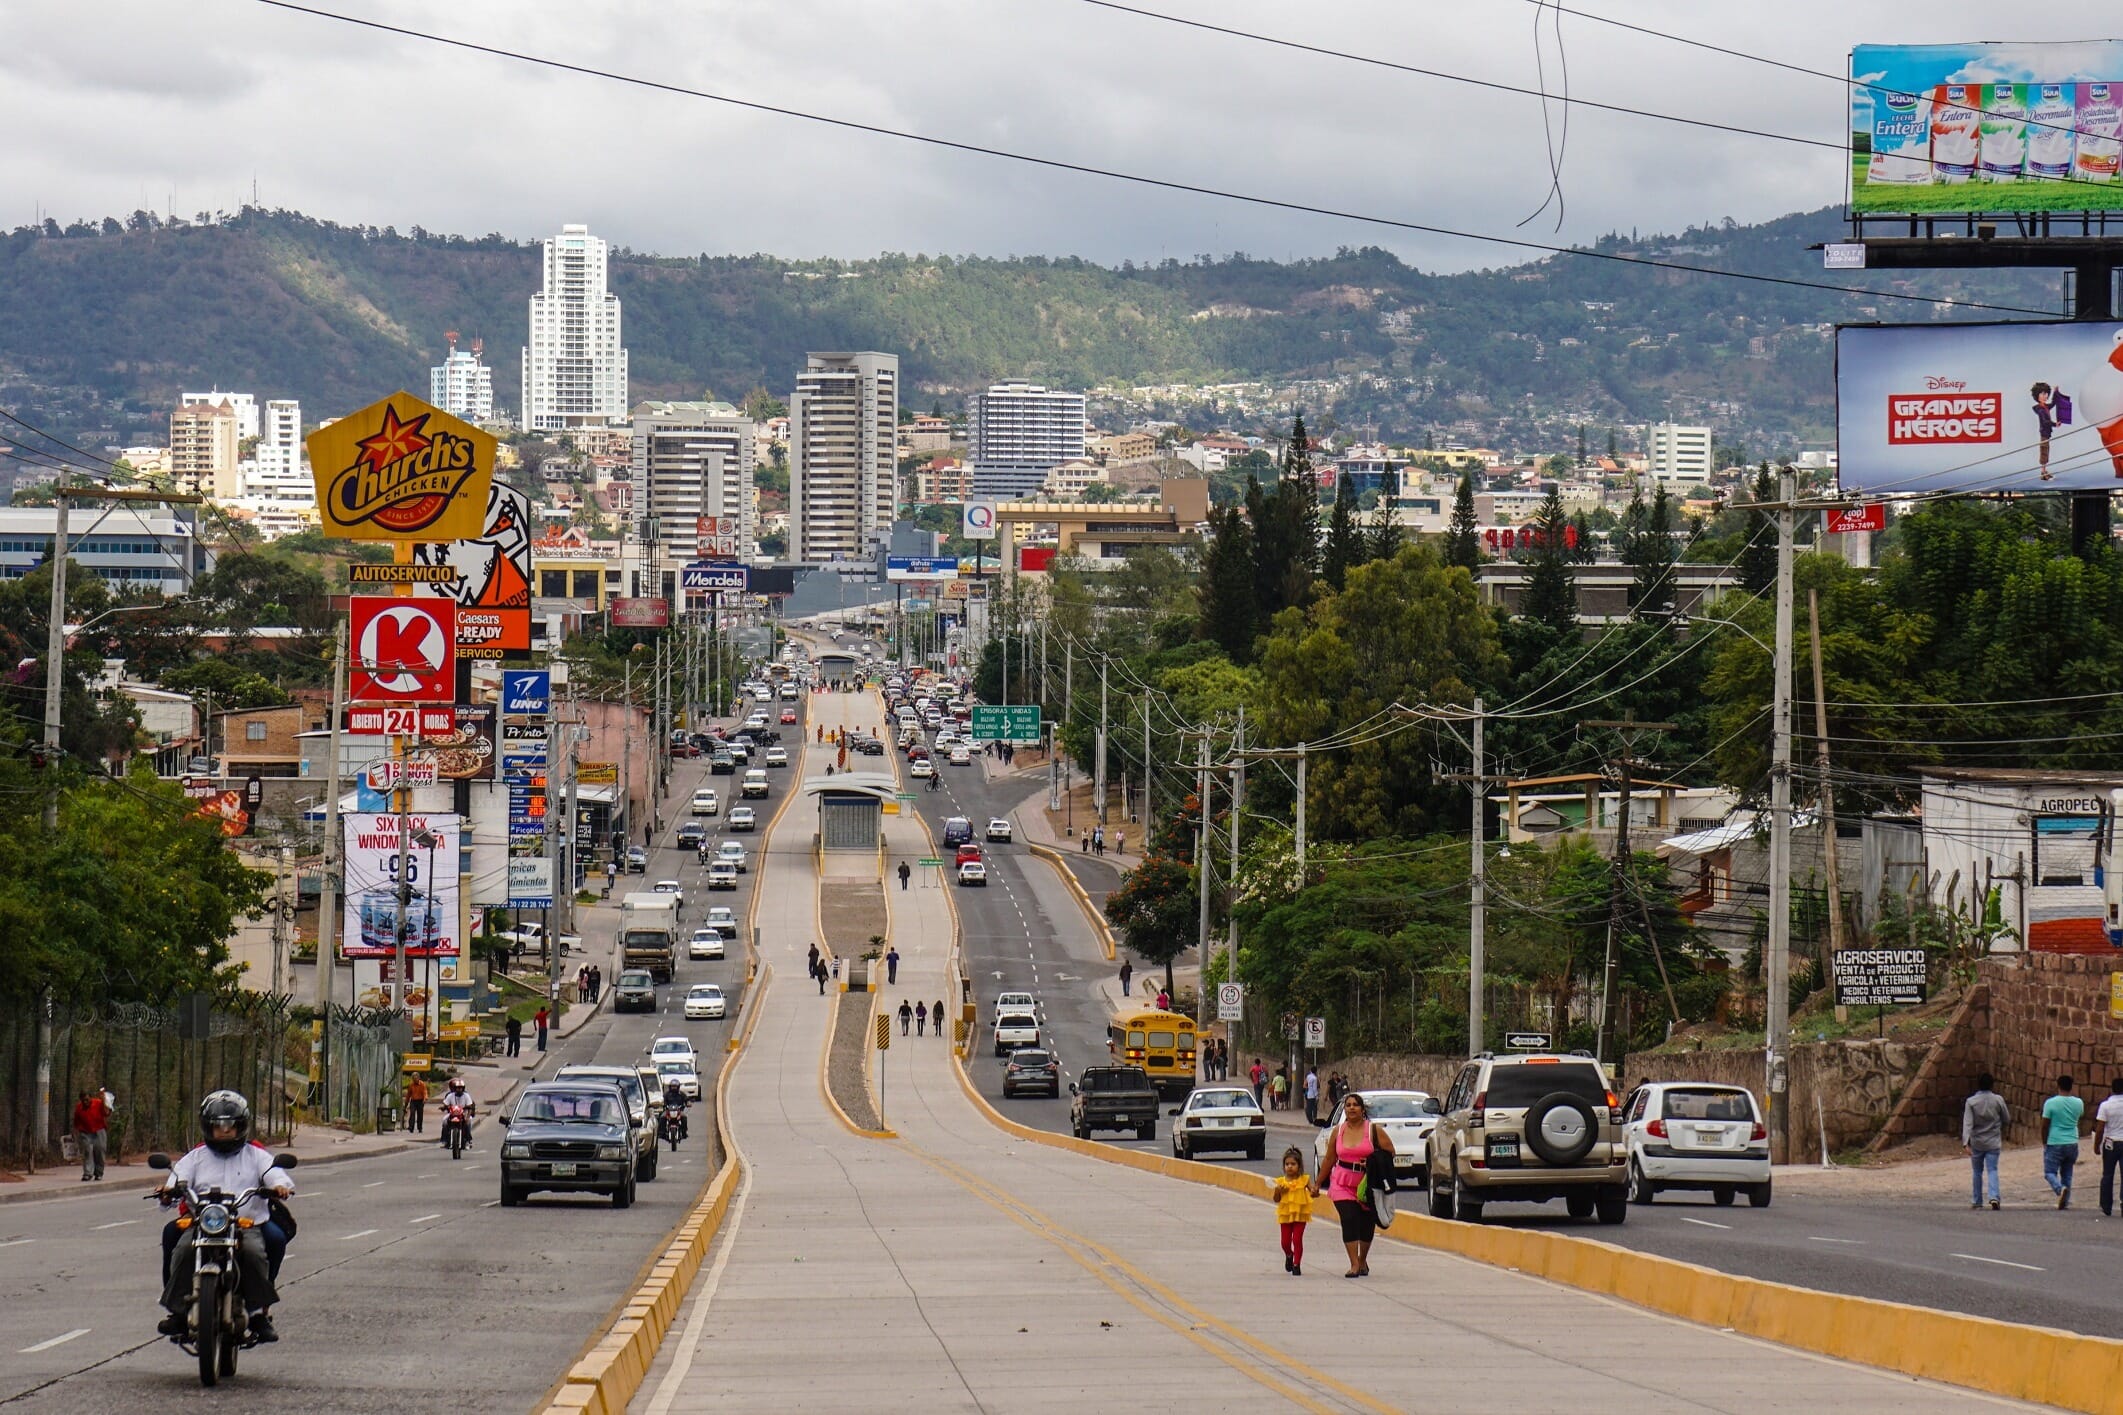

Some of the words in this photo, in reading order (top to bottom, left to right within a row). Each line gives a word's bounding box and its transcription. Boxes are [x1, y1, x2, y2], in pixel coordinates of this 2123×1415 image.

[1996, 89, 2011, 97] SULA
[2043, 89, 2059, 97] SULA
[2092, 87, 2108, 96] SULA
[1940, 110, 1973, 121] Entera
[2029, 107, 2072, 121] Descremada
[1876, 120, 1925, 135] Entera
[1923, 376, 1967, 392] Disney
[1894, 399, 1996, 416] GRANDES
[1894, 416, 1997, 439] HÉROES
[329, 433, 471, 522] Church's
[385, 476, 450, 502] CHICKEN
[387, 511, 415, 520] SINCE
[967, 506, 993, 528] Q
[1837, 522, 1876, 531] 2239-7499
[353, 566, 451, 581] AUTOSERVICIO
[684, 572, 743, 587] Mendels
[458, 611, 500, 625] Caesars
[510, 699, 543, 710] UNO
[351, 714, 382, 729] ABIERTO
[387, 711, 416, 733] 24
[424, 714, 449, 729] HORAS
[392, 762, 436, 770] DNKIN'
[392, 771, 433, 779] DNUTS
[2040, 798, 2107, 811] AGROPEC
[376, 816, 395, 832] SIX
[398, 817, 428, 831] ACK
[358, 834, 416, 850] WINDML
[380, 858, 388, 872] L.
[1836, 950, 1925, 965] AGROSERVICIO
[1835, 965, 1865, 975] VENTA
[1877, 964, 1926, 974] PRODUCTO
[1837, 975, 1874, 986] AGRICOLA
[1879, 975, 1926, 985] VETERINARIO
[1225, 988, 1236, 998] 25
[1843, 986, 1869, 996] MEDICO
[1872, 986, 1918, 995] VETERINARIO
[1841, 996, 1892, 1005] CONSULTENOS
